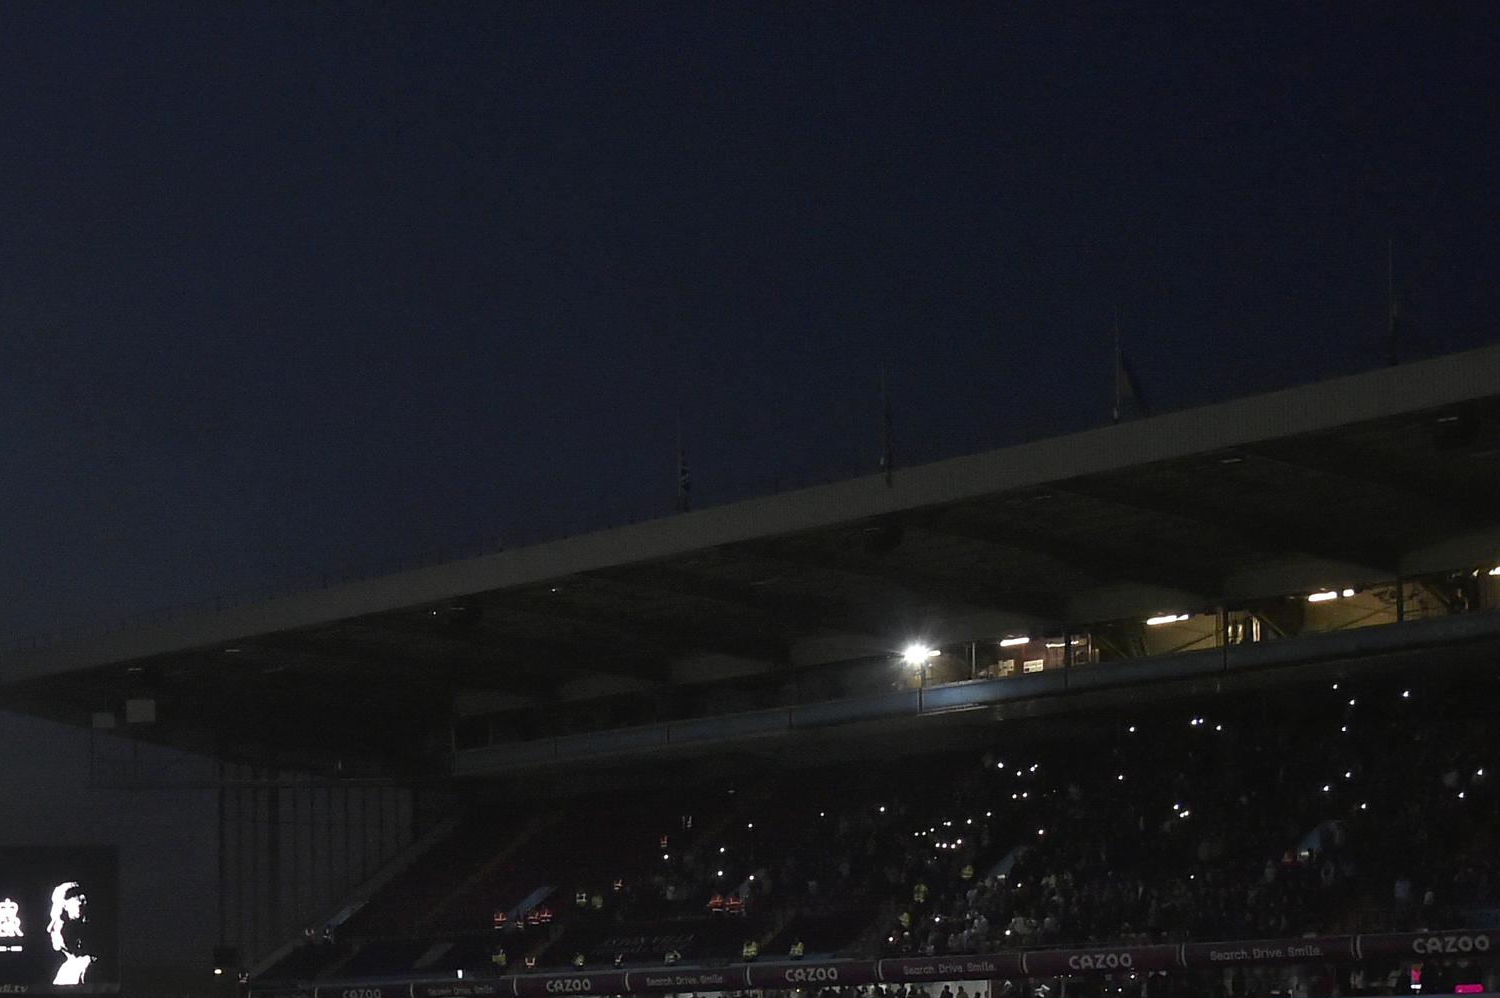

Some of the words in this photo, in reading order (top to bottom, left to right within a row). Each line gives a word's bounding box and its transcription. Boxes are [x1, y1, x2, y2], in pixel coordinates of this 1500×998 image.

[1412, 934, 1490, 954] CAZOO
[1068, 953, 1132, 970] CAZOO
[785, 967, 838, 982] CAZOO
[546, 978, 591, 992] CAZOO
